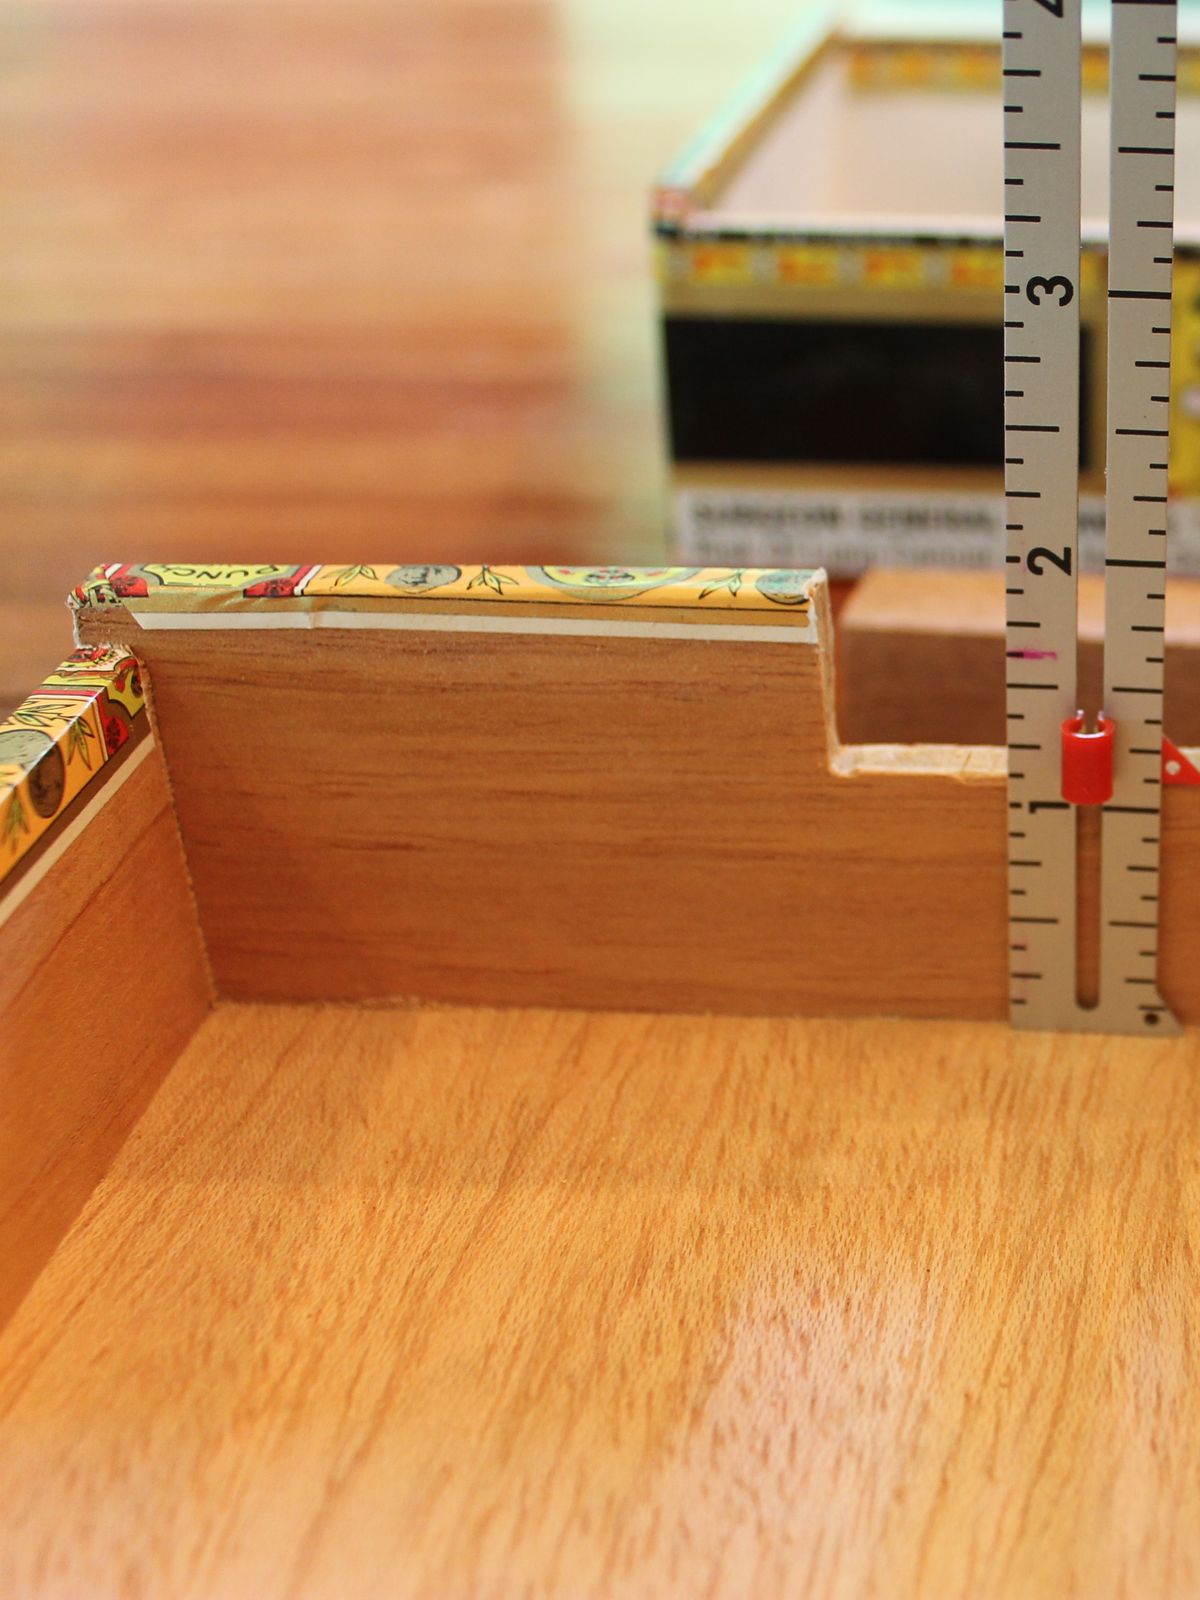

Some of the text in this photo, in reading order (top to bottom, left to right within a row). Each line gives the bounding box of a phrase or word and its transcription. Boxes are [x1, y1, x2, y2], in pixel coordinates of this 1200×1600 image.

[1026, 276, 1073, 306] 3
[1027, 547, 1071, 576] 2
[1028, 801, 1070, 814] 1
